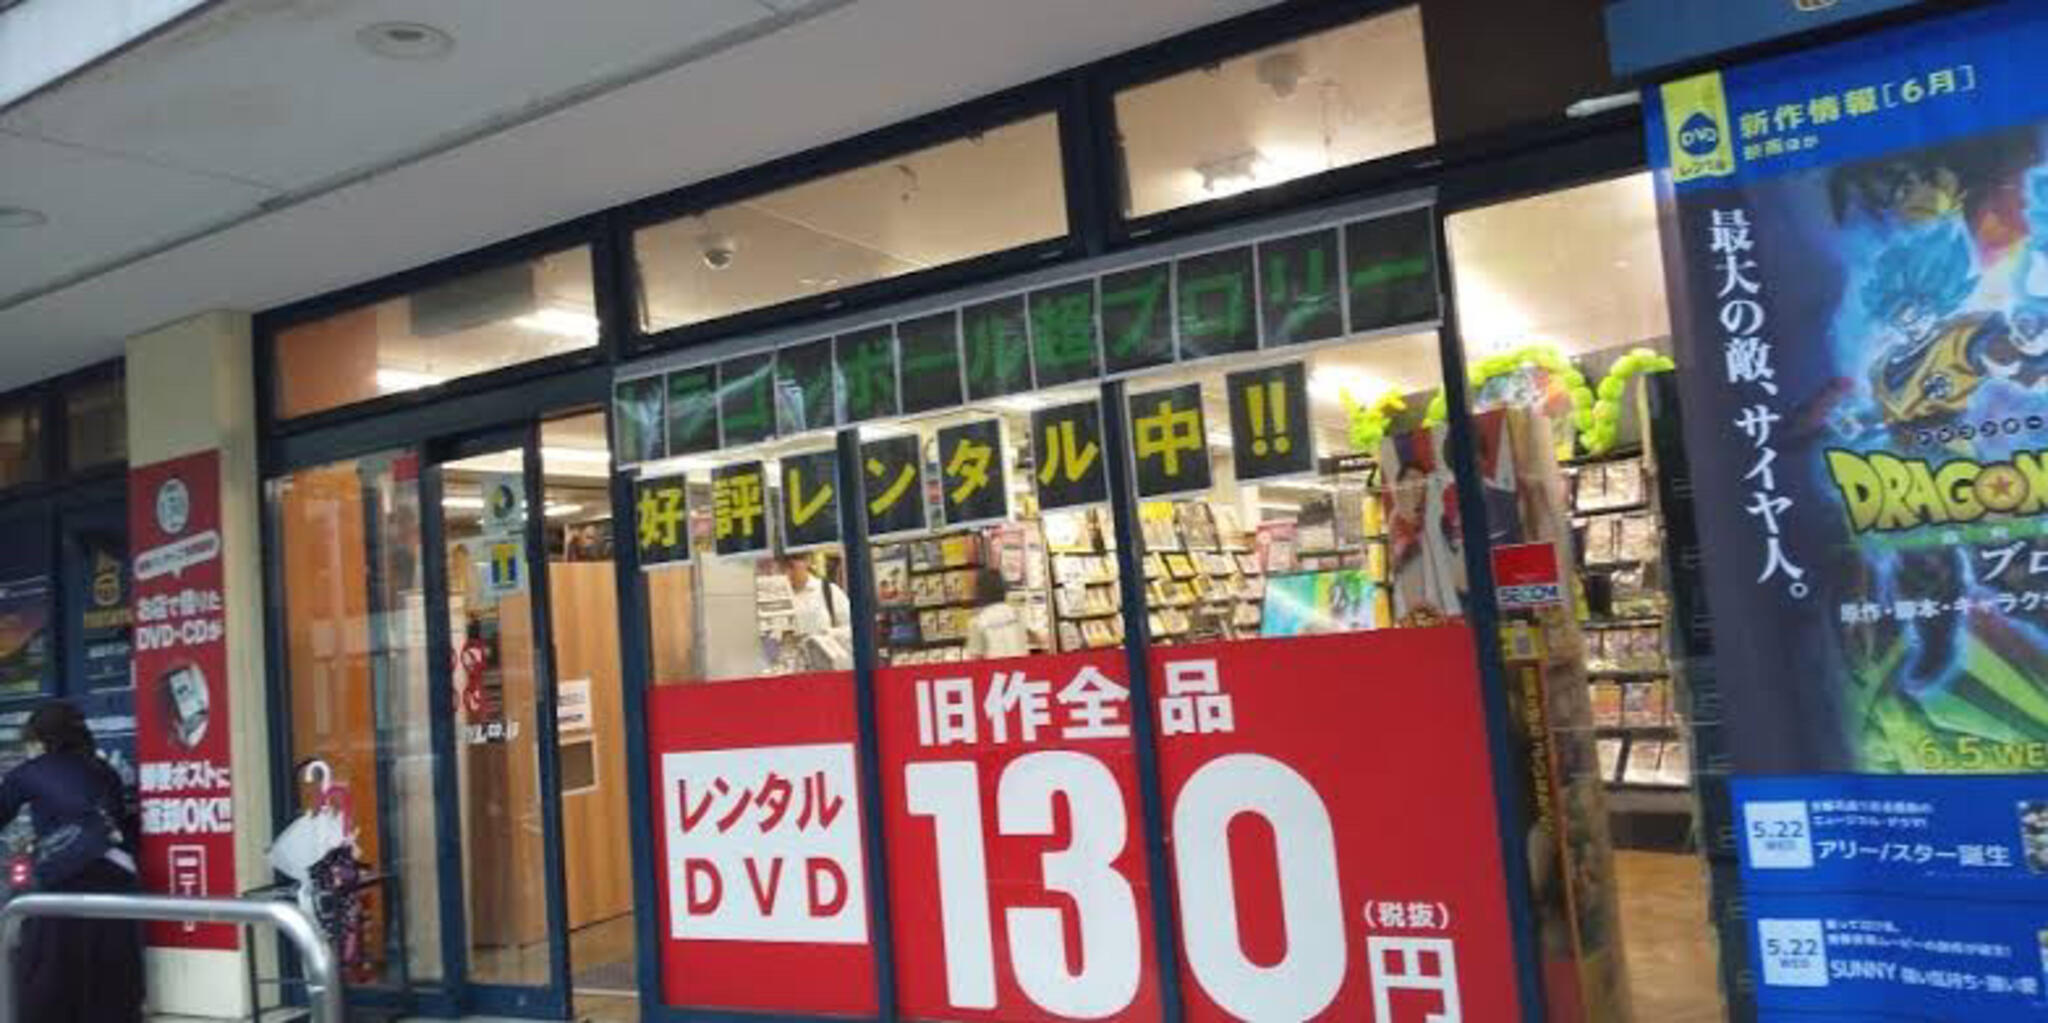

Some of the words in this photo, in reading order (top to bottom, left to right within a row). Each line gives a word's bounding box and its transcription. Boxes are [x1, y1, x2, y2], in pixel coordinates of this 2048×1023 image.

[915, 658, 1234, 746] 旧作全品
[678, 771, 843, 833] レンタル
[1753, 820, 1804, 839] 5.22
[684, 857, 849, 917] DVD
[1766, 938, 1819, 956] 5.22
[1829, 959, 1897, 981] SUNNY
[1366, 936, 1464, 1023] 円
